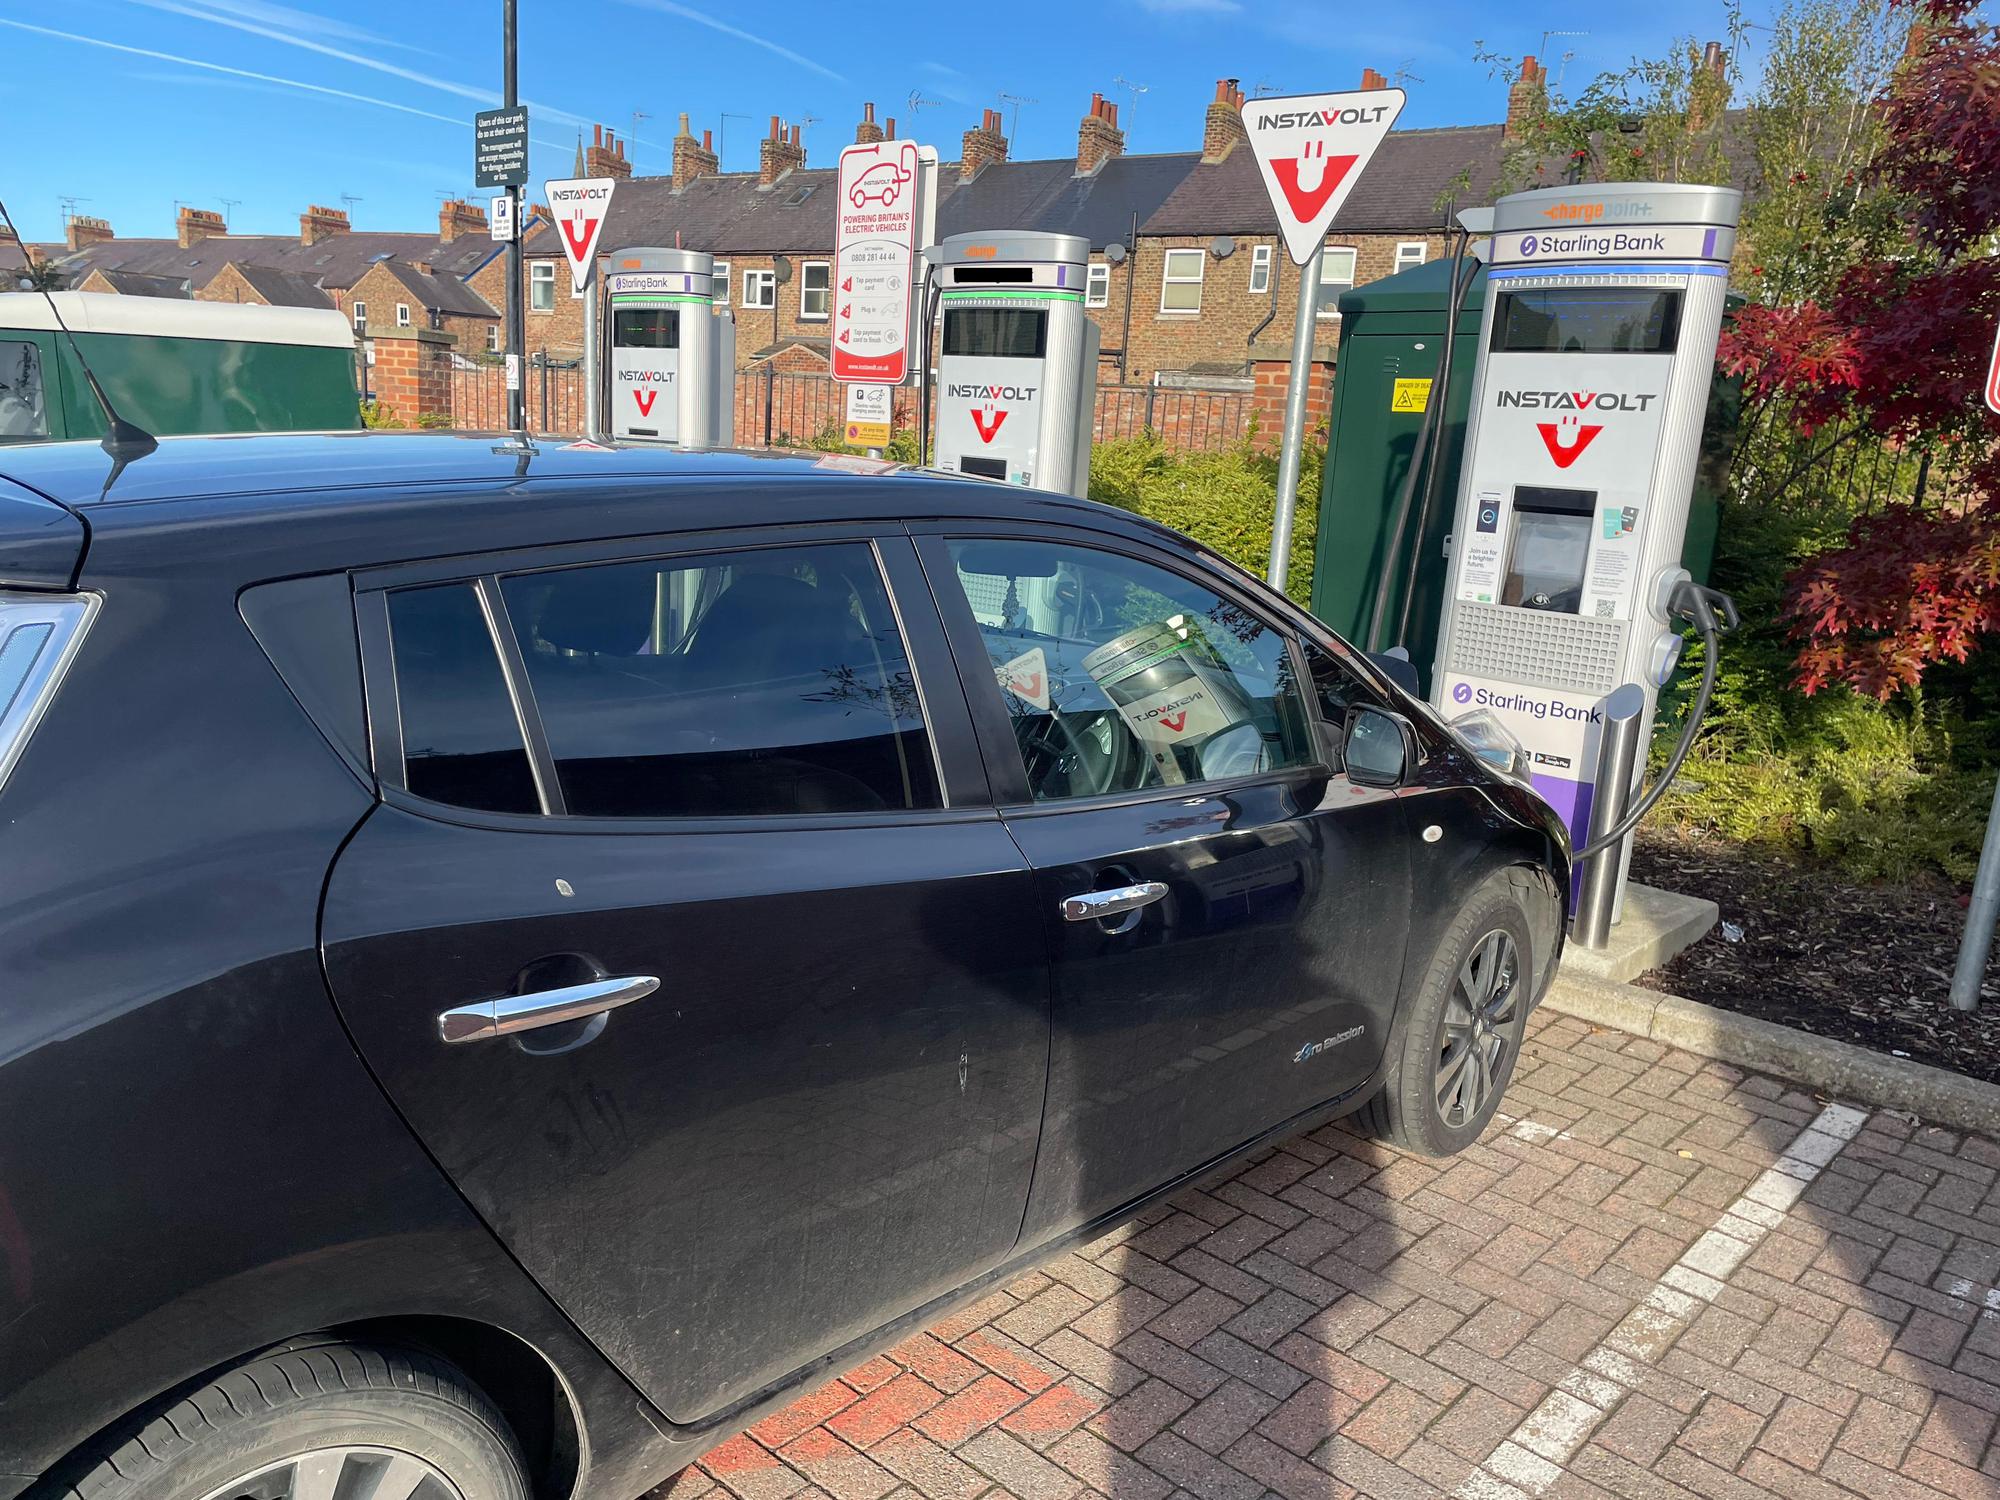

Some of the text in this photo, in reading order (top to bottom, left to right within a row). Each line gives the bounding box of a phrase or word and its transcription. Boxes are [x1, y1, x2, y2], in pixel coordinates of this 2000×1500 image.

[478, 118, 491, 127] Users
[492, 116, 497, 125] of
[513, 113, 523, 124] park
[1258, 106, 1389, 130] INSTAVOLT
[477, 130, 483, 138] do
[495, 128, 505, 136] their
[481, 144, 489, 152] The
[490, 143, 513, 152] management
[486, 154, 498, 162] accept
[499, 150, 524, 161] responsibility
[504, 161, 520, 169] accident
[553, 188, 608, 200] INSTAVOLT
[844, 212, 910, 224] POWERING BRITAIN'S
[845, 222, 906, 233] ELECTRIC VEHICLES
[1541, 233, 1665, 255] Starling Bank
[851, 254, 865, 262] 0808
[622, 277, 668, 290] Starling Bank
[618, 370, 675, 382] INSTAVOLT
[948, 384, 1037, 401] INSTAVOLT
[1497, 389, 1657, 412] INSTAVOLT
[1476, 688, 1602, 725] Starling Bank
